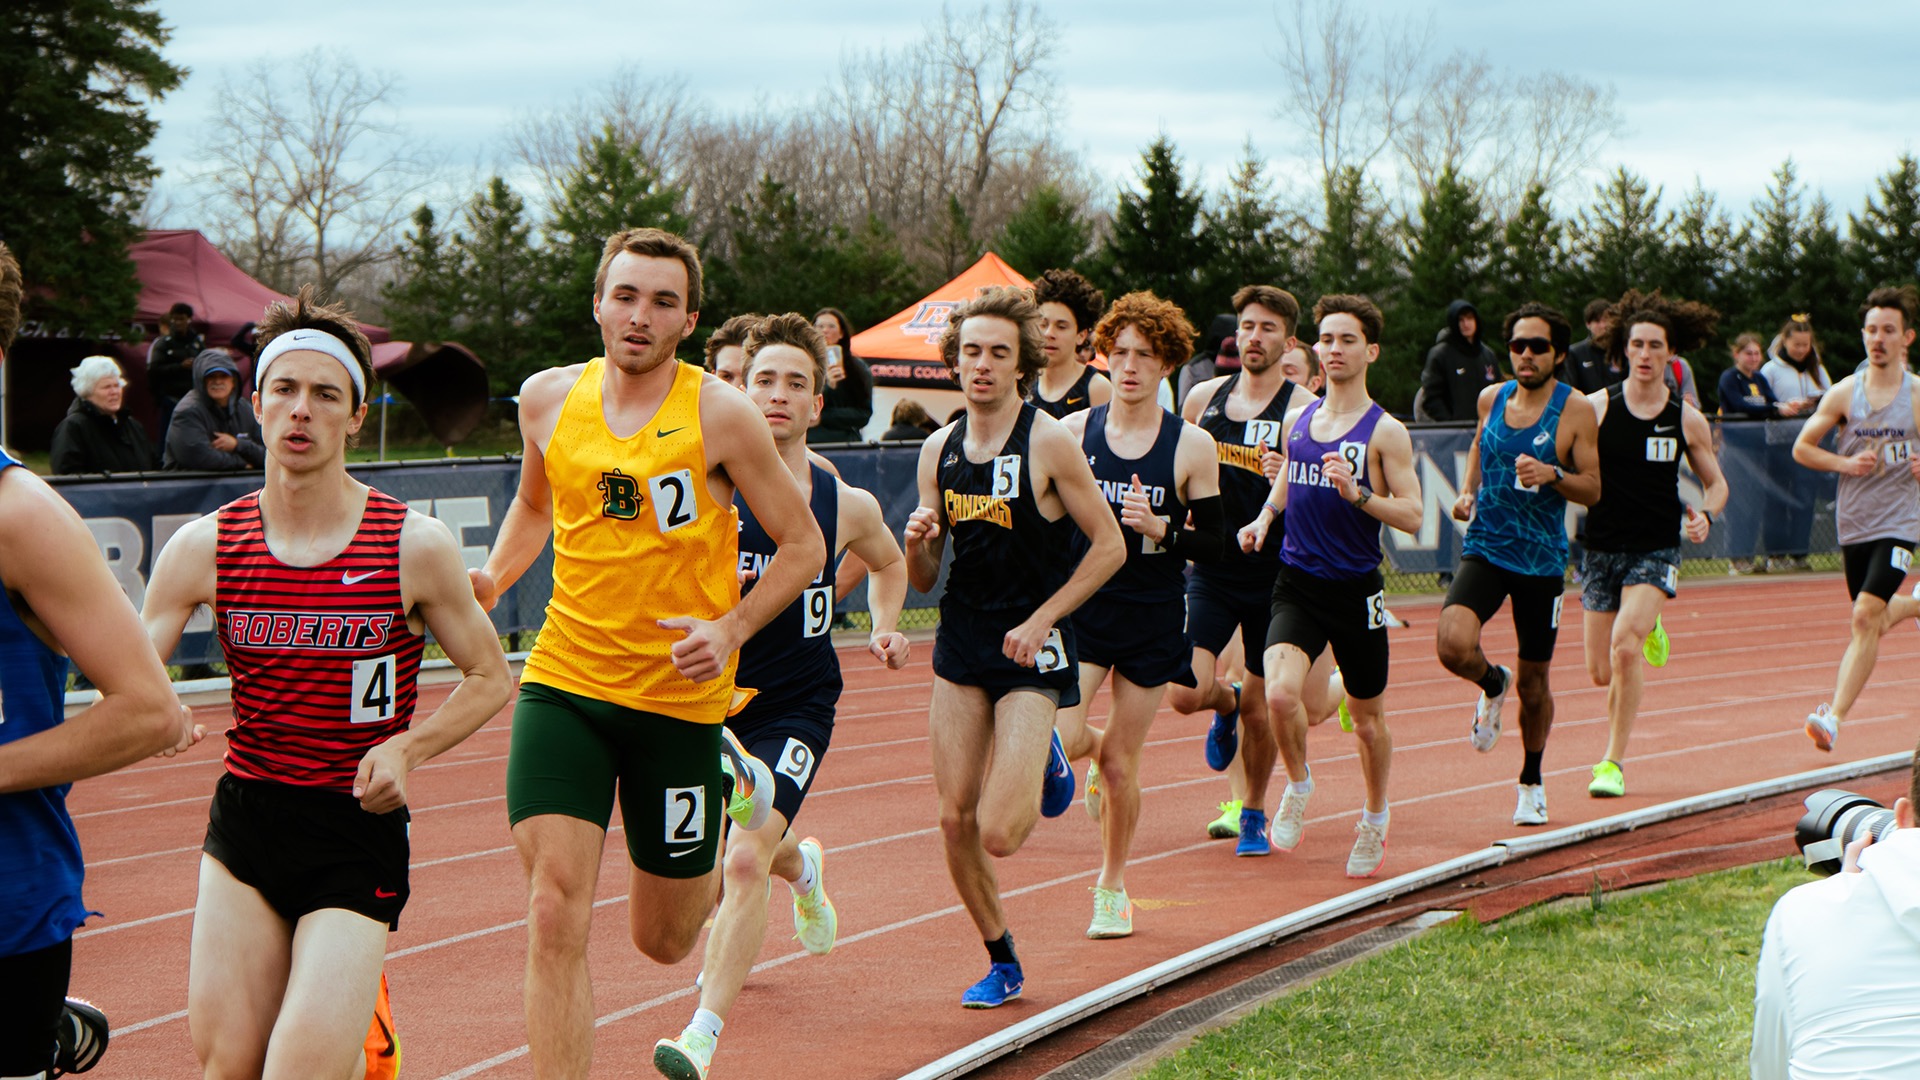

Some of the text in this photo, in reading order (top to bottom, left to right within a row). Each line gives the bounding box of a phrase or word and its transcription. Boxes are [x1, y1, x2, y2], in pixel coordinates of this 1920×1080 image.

[914, 365, 954, 380] COUN
[1252, 422, 1271, 444] 12
[1652, 440, 1670, 459] 11
[1217, 441, 1265, 476] NISIUS
[1345, 445, 1359, 476] 8
[1890, 442, 1908, 461] 14
[998, 458, 1013, 496] 5
[1287, 460, 1340, 488] IAGA
[658, 476, 691, 528] 2
[810, 590, 827, 635] 9
[1373, 595, 1384, 626] 8
[229, 612, 392, 650] ROBERTS
[361, 660, 391, 718] 4
[785, 744, 809, 777] 9
[673, 791, 698, 840] 2
